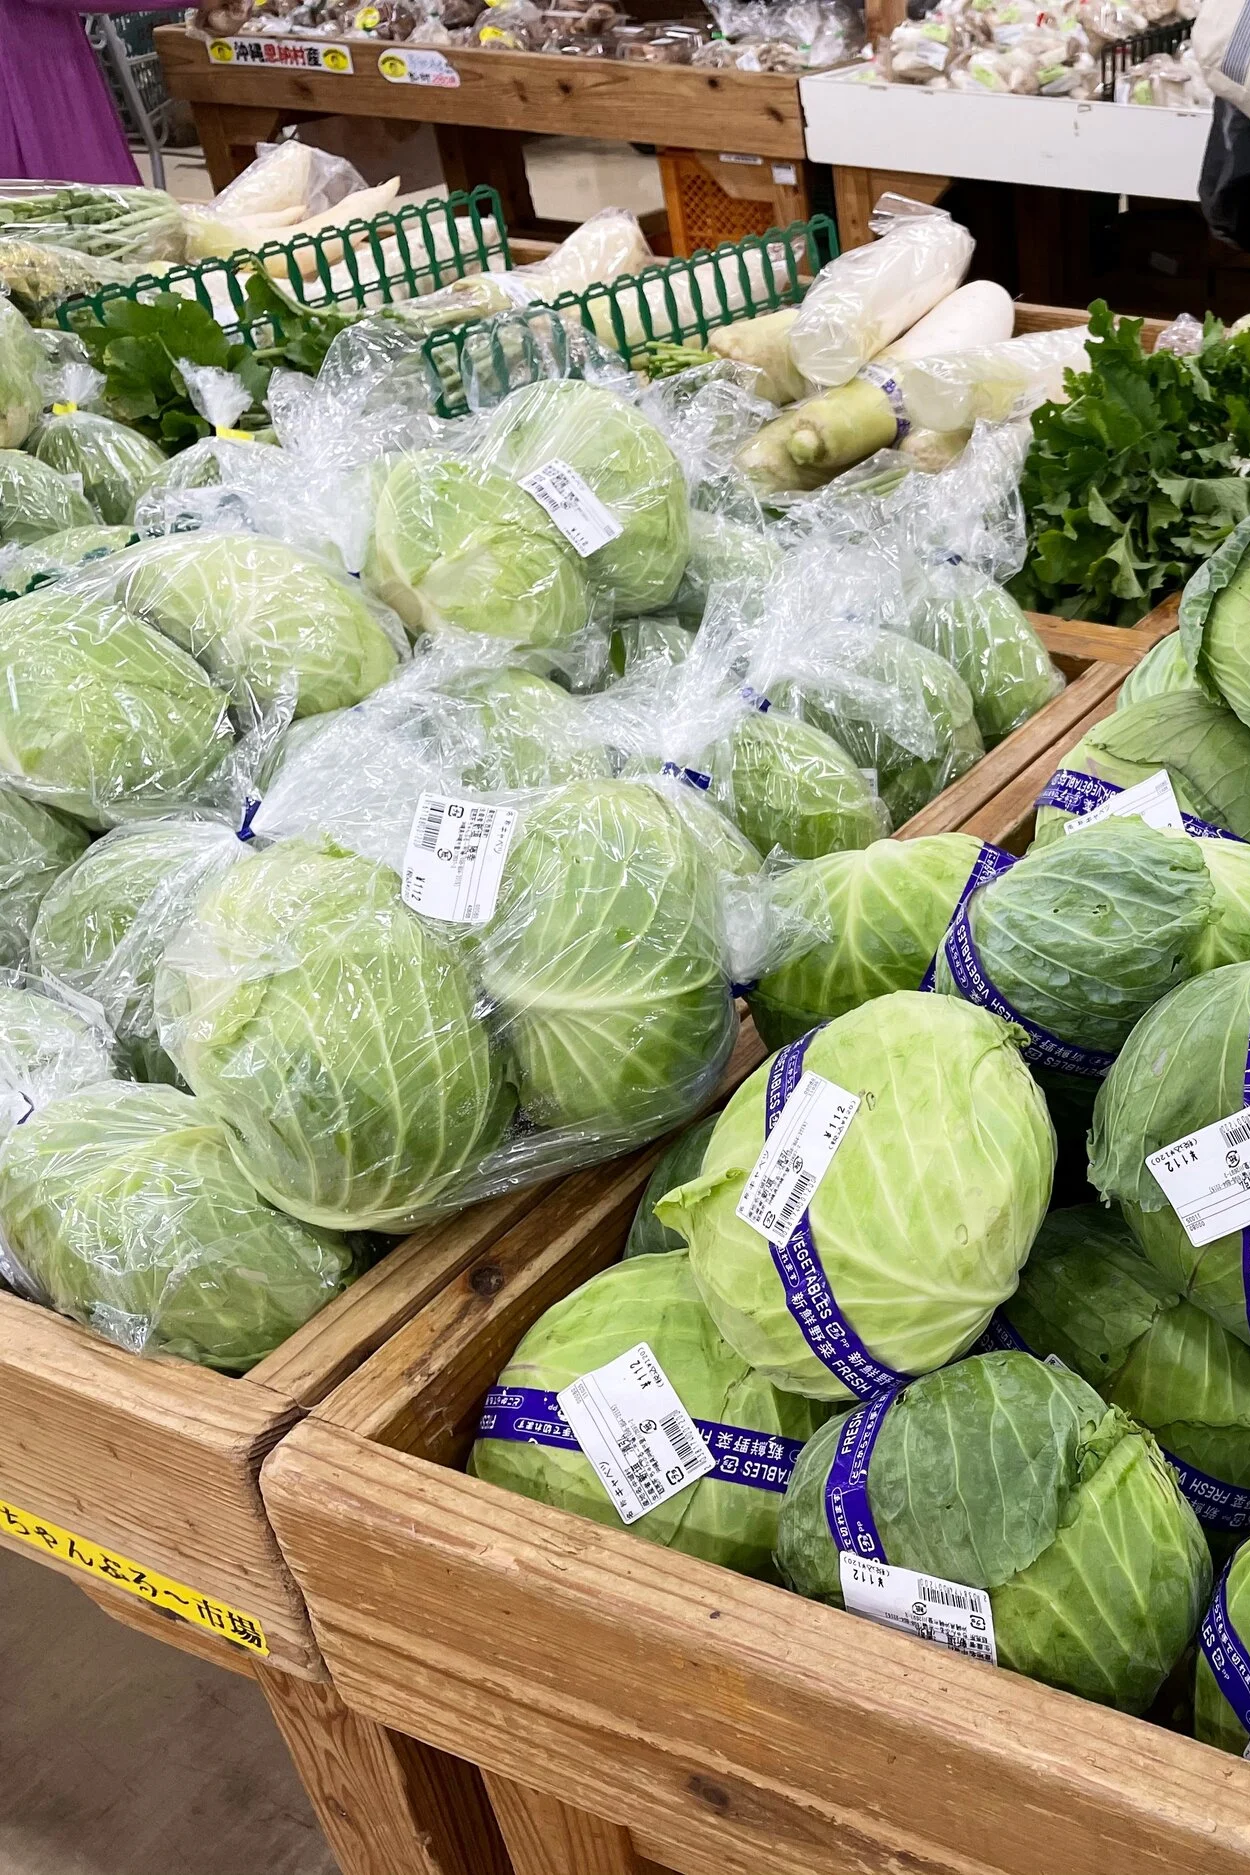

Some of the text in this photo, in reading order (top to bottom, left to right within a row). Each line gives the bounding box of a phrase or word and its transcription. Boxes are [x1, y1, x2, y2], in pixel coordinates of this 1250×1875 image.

[410, 875, 425, 901] ¥112
[956, 924, 990, 999] VEGETABLES
[1163, 1149, 1198, 1173] ¥112
[793, 1230, 832, 1319] VEGETABLES
[791, 1291, 836, 1359] 新鮮野菜
[832, 1359, 870, 1395] FRESH
[718, 1431, 785, 1460] 新鮮野菜
[841, 1411, 866, 1455] FRESH
[598, 1458, 625, 1498] キャベツ
